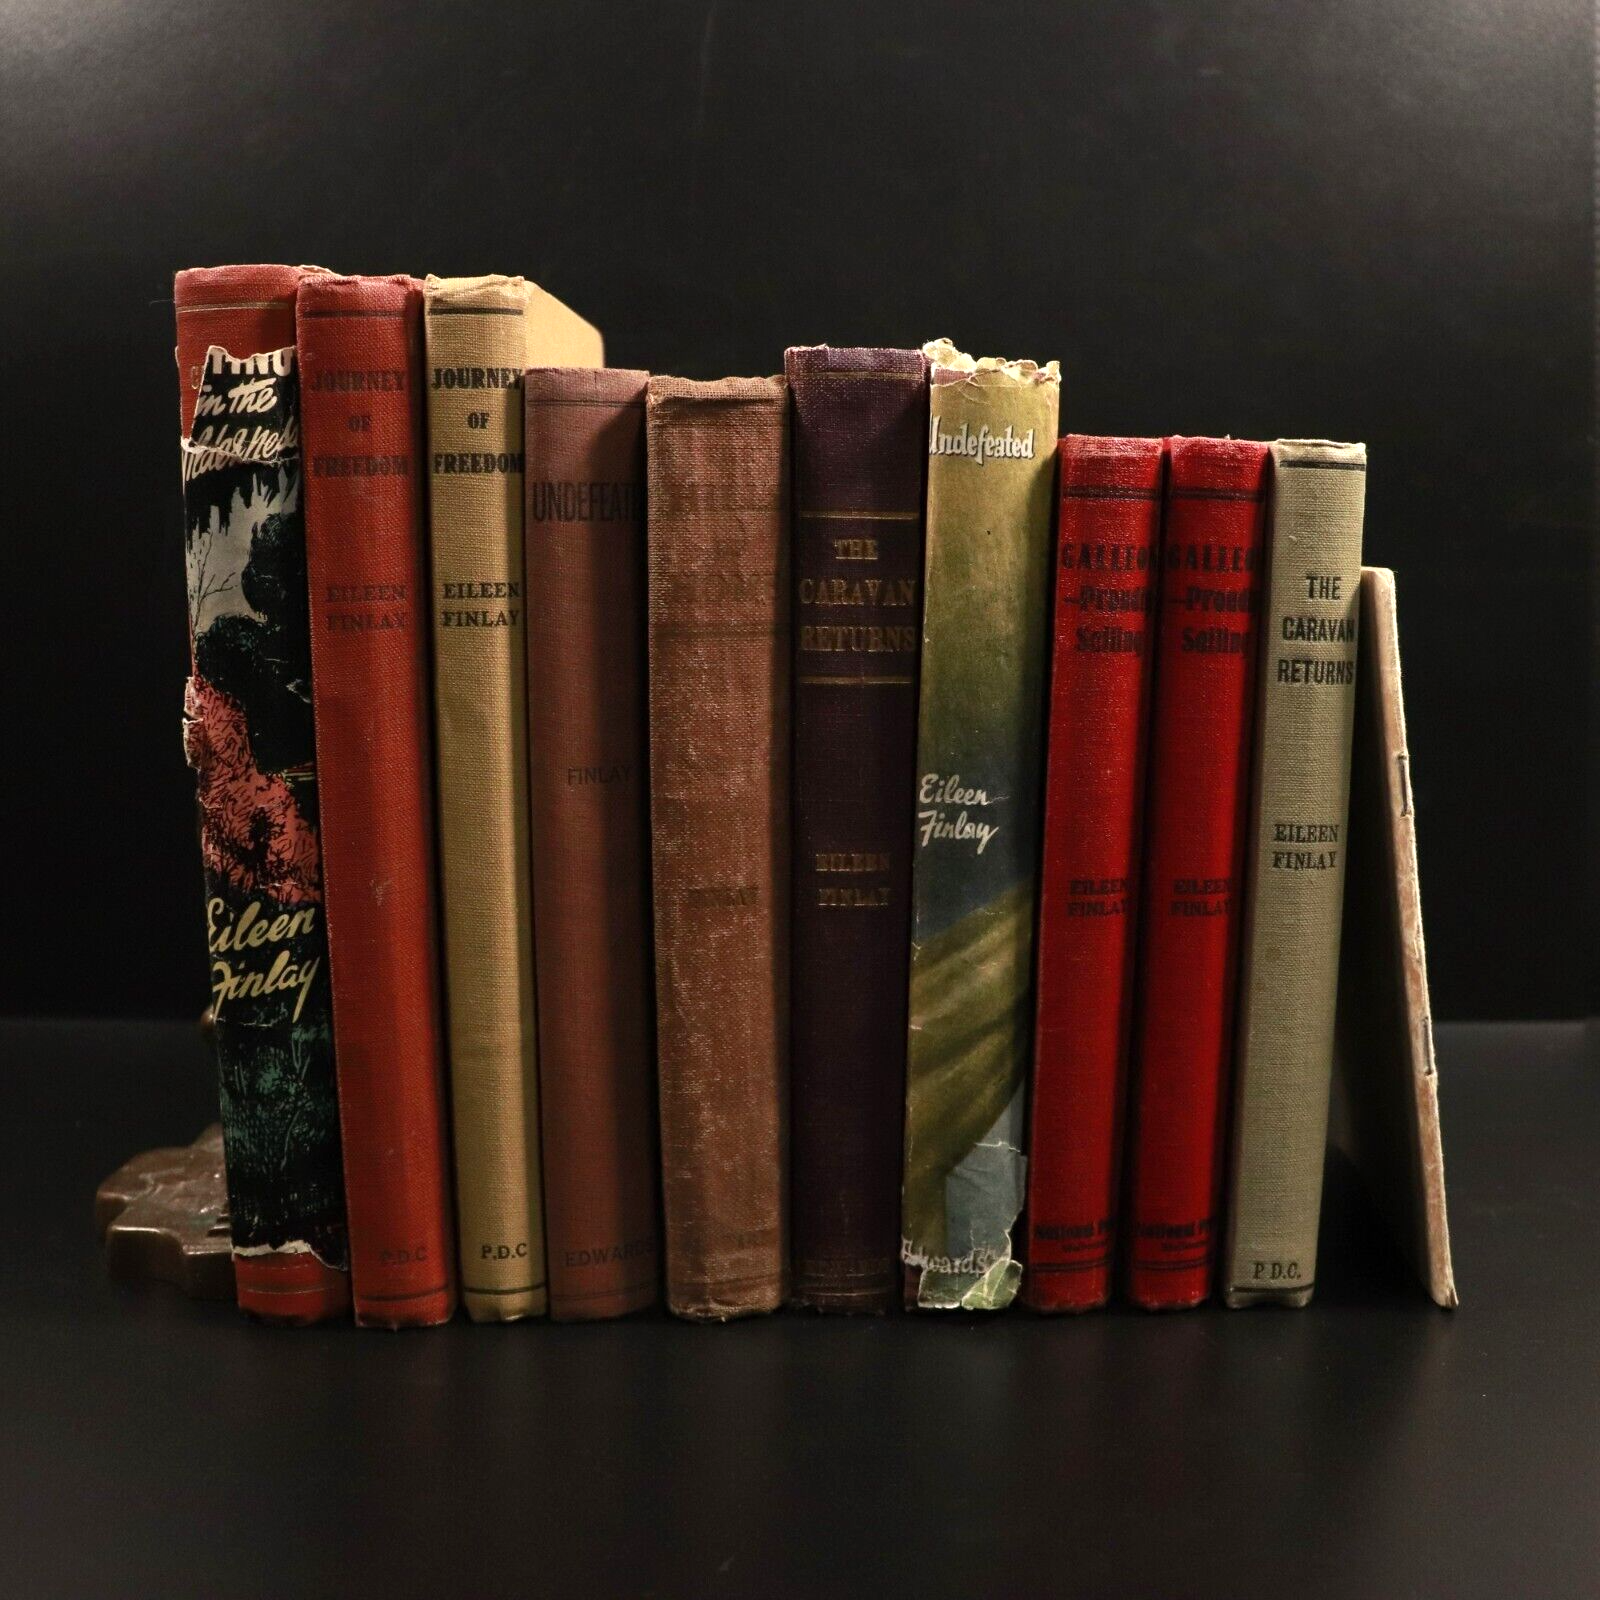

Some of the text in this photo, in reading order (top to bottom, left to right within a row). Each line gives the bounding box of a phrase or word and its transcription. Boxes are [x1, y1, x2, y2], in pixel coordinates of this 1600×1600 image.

[309, 370, 405, 392] JOURNEY
[431, 367, 523, 390] JOURNEY
[349, 414, 372, 432] OF
[467, 412, 490, 430] OF
[313, 455, 409, 477] FREEDOM
[433, 452, 524, 474] FREEDOM
[835, 537, 879, 560] THE
[327, 584, 408, 602] EILEEN
[441, 581, 522, 600] EILEEN
[799, 578, 916, 606] CARAVAN
[1306, 575, 1342, 601] THE
[327, 612, 407, 632] FINLAY
[442, 609, 521, 628] FINLAY
[1282, 616, 1355, 642] CARAVAN
[799, 625, 917, 653] RETURNS
[1277, 659, 1355, 686] RETURNS
[567, 768, 633, 786] FINLAY
[918, 772, 991, 806] Eileen
[917, 809, 1000, 855] Finlay
[1273, 823, 1340, 843] EILEEN
[1271, 851, 1337, 871] FINLAY
[207, 896, 314, 954] Eileen
[211, 948, 321, 1024] Finlay
